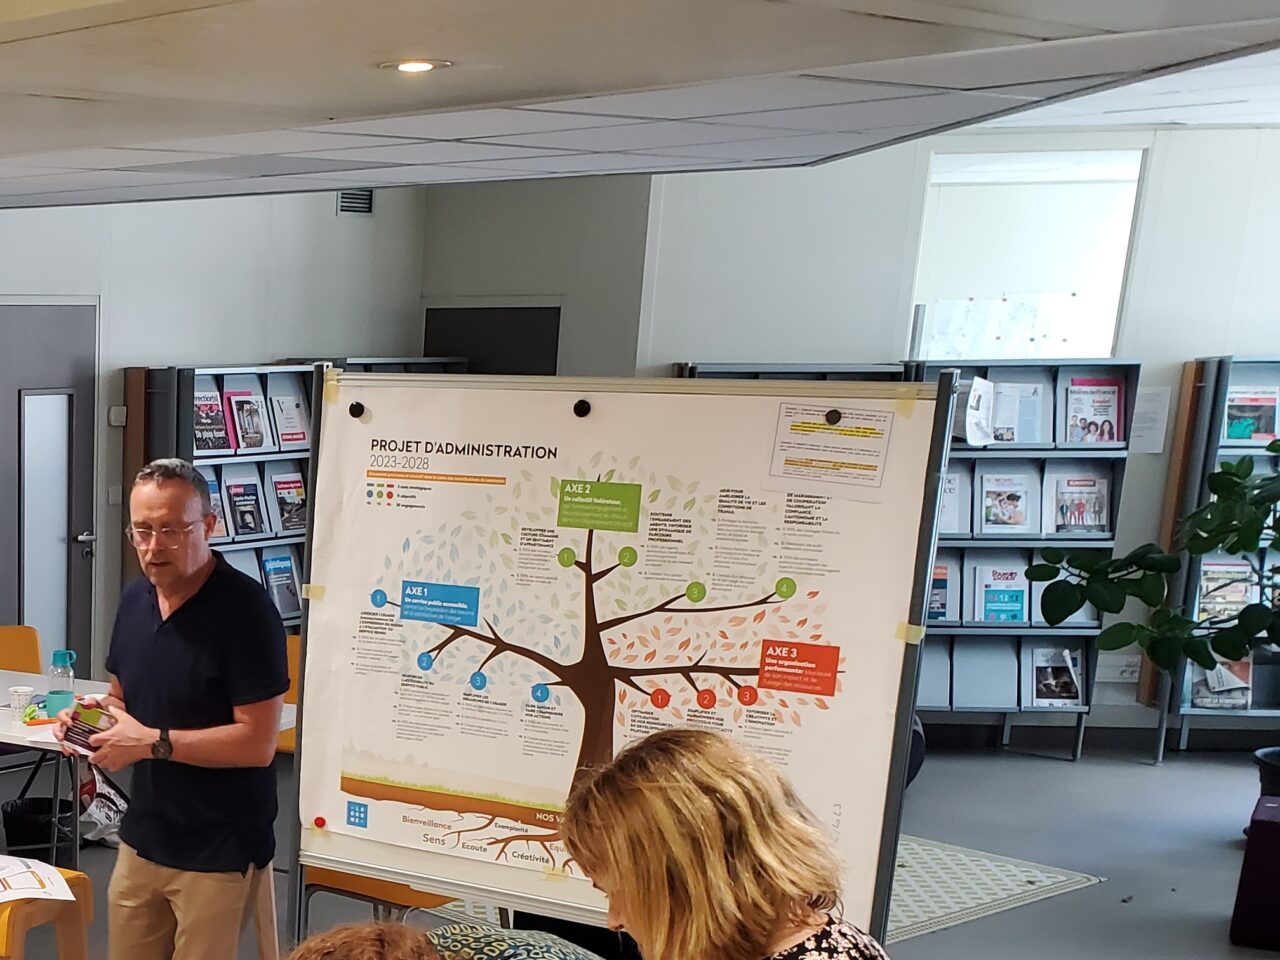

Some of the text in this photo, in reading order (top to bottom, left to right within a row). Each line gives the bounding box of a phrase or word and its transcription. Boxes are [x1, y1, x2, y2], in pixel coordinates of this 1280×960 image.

[370, 438, 558, 460] PROJET D'ADMINISTRATION
[369, 454, 430, 471] 2023-2028
[564, 483, 592, 494] AXE 2
[623, 553, 630, 563] 2
[405, 586, 428, 596] AXE 1
[692, 588, 698, 598] 3
[780, 583, 787, 593] 4
[766, 646, 798, 658] AXE 3
[422, 658, 428, 666] 2
[778, 658, 817, 669] organisation
[475, 677, 481, 687] 3
[535, 688, 543, 698] 4
[743, 691, 750, 701] 3
[703, 694, 710, 705] 2
[535, 811, 556, 823] NOS
[402, 815, 453, 831] Bienveillance
[494, 822, 529, 834] Exemplarité
[422, 833, 446, 847] Sens
[461, 842, 488, 854] Ecoute
[511, 850, 551, 865] Créativité
